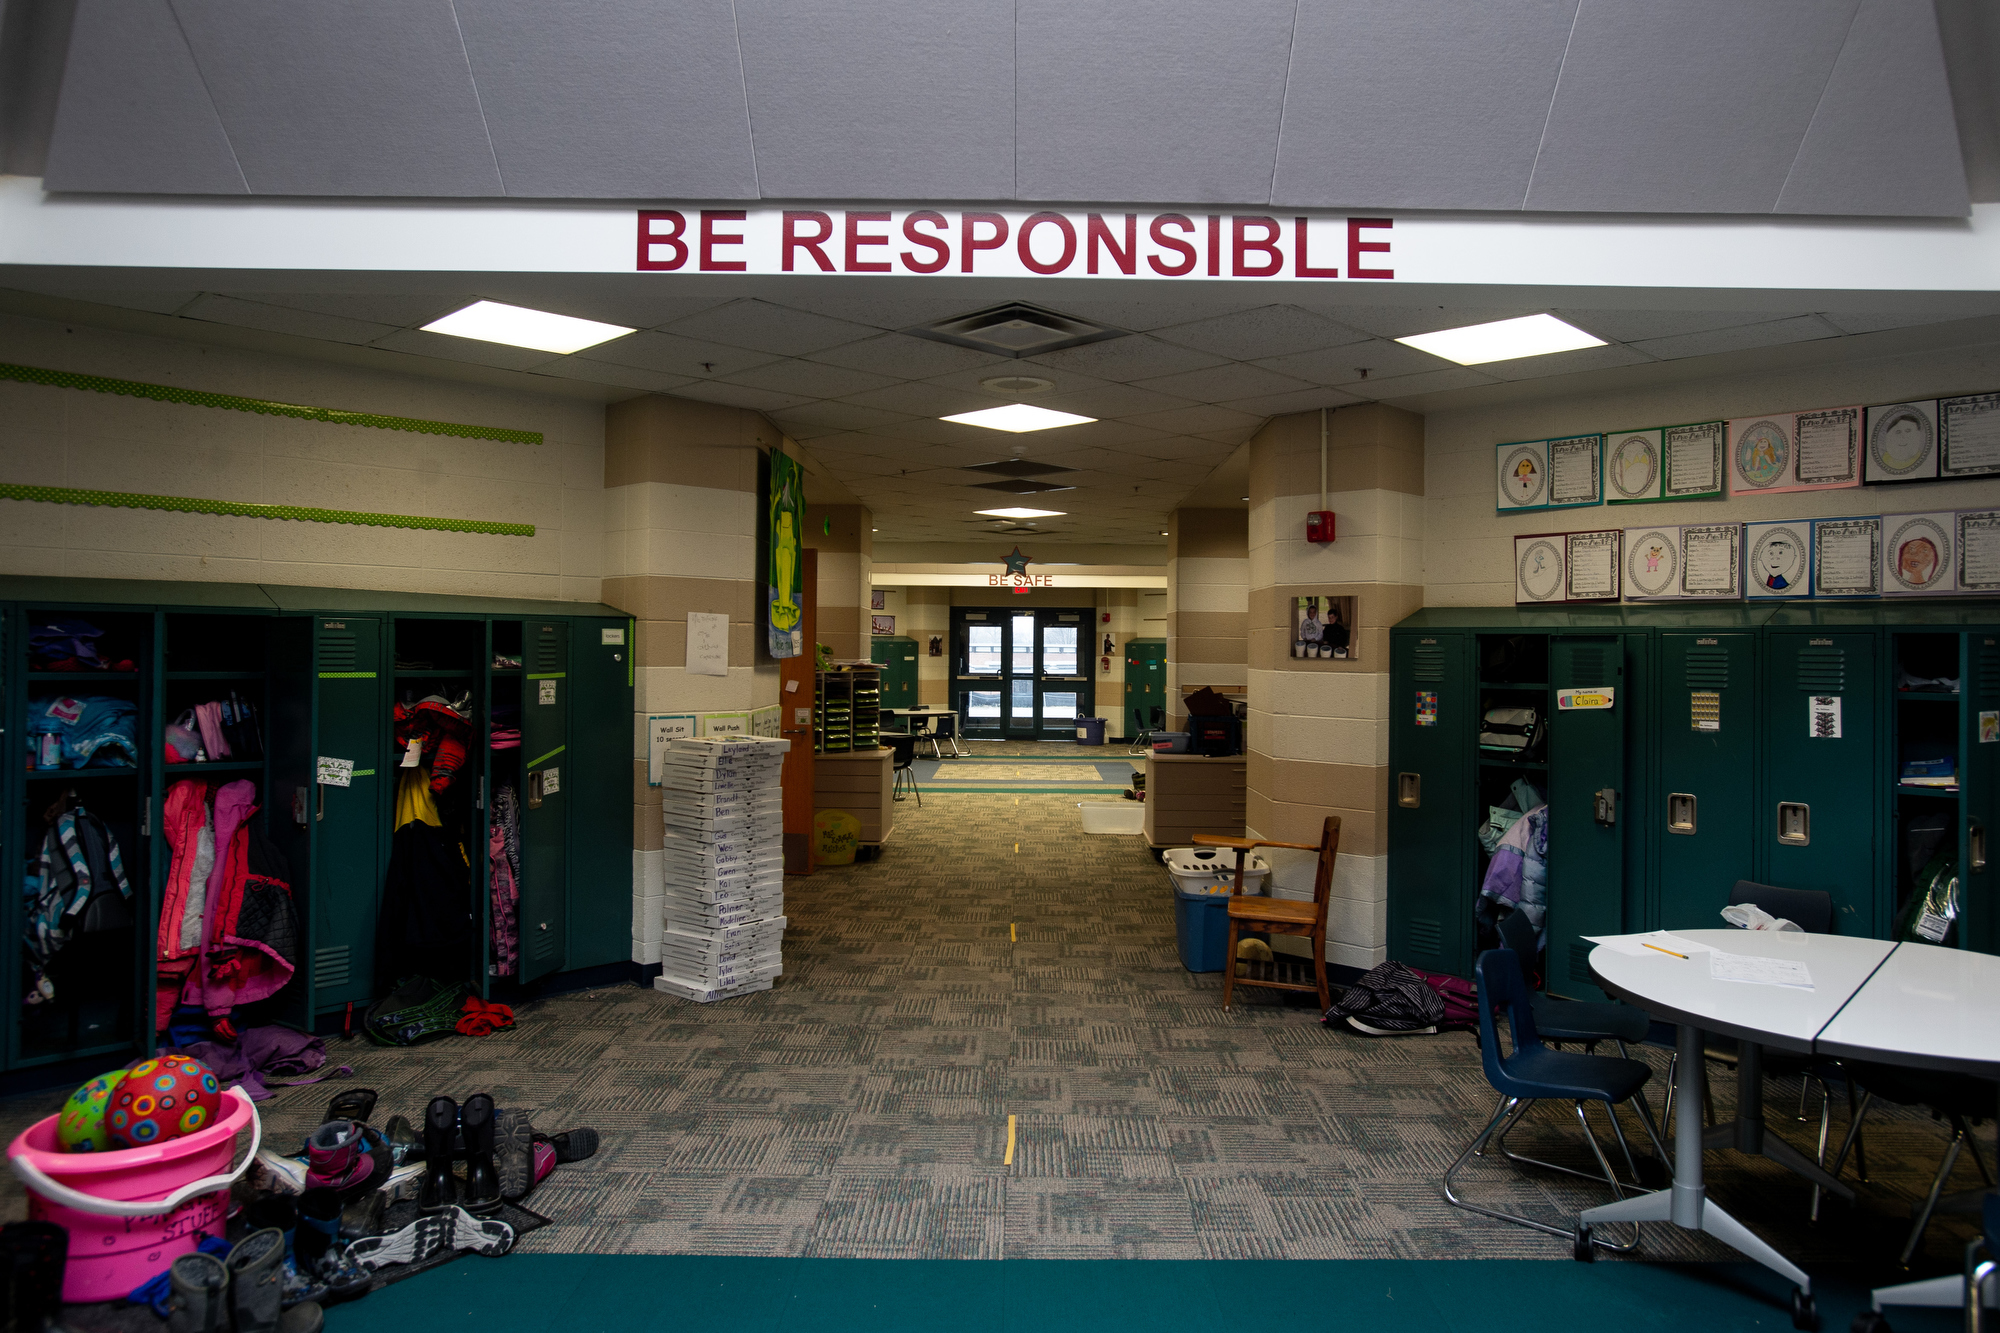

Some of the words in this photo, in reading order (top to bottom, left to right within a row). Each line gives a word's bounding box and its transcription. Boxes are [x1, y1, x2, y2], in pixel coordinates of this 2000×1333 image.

[637, 210, 747, 271] BE
[781, 211, 1395, 279] RESPONSIBLE
[989, 575, 1008, 586] BE
[1013, 575, 1053, 587] SAFE
[1576, 696, 1599, 705] Claira
[716, 807, 730, 816] Ben
[715, 832, 727, 840] Gus
[716, 855, 738, 865] Gabby
[718, 867, 736, 877] Gwen
[719, 880, 731, 889] Kai
[715, 892, 729, 901] Leo
[719, 903, 744, 915] Palmer
[718, 965, 733, 976] Tyler
[163, 1202, 219, 1240] STUFF
